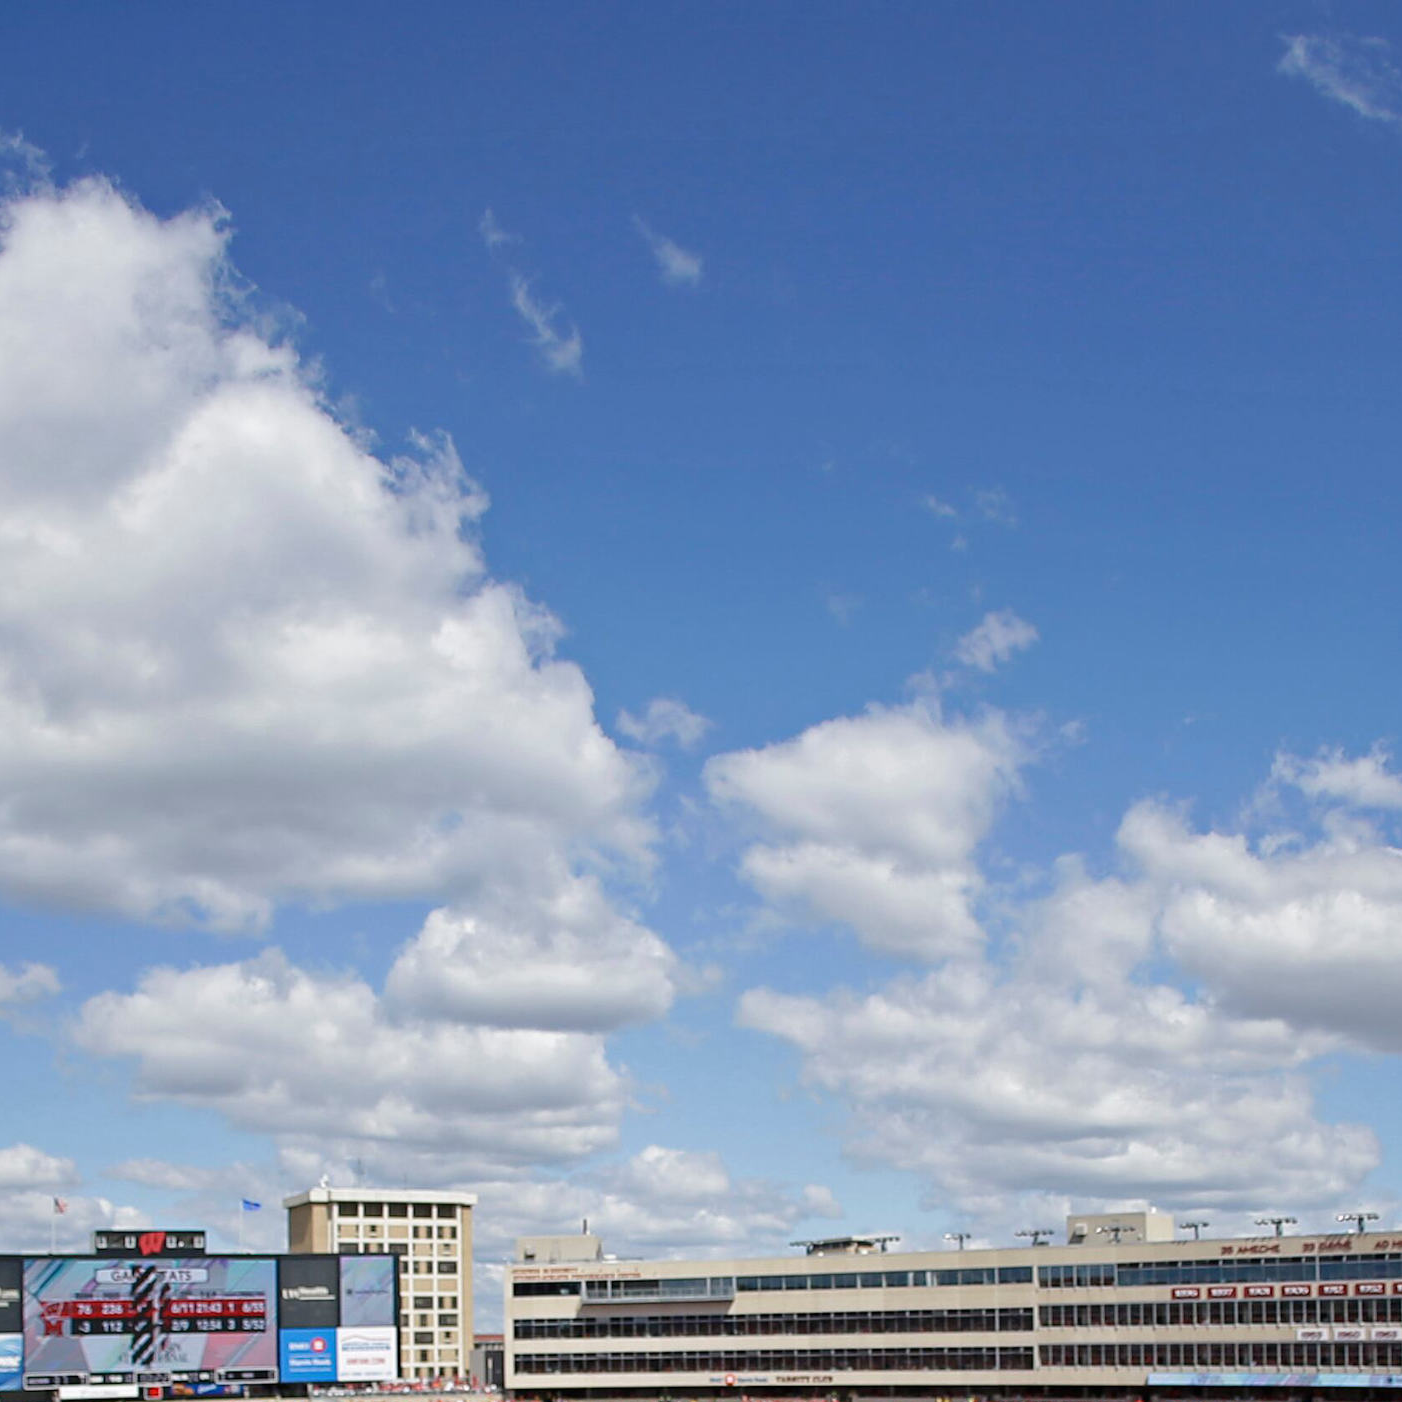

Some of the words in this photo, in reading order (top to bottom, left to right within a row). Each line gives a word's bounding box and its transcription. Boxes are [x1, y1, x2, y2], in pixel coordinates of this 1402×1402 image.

[77, 1303, 93, 1315] 76
[171, 1303, 194, 1314] 6/11
[102, 1320, 123, 1332] 112
